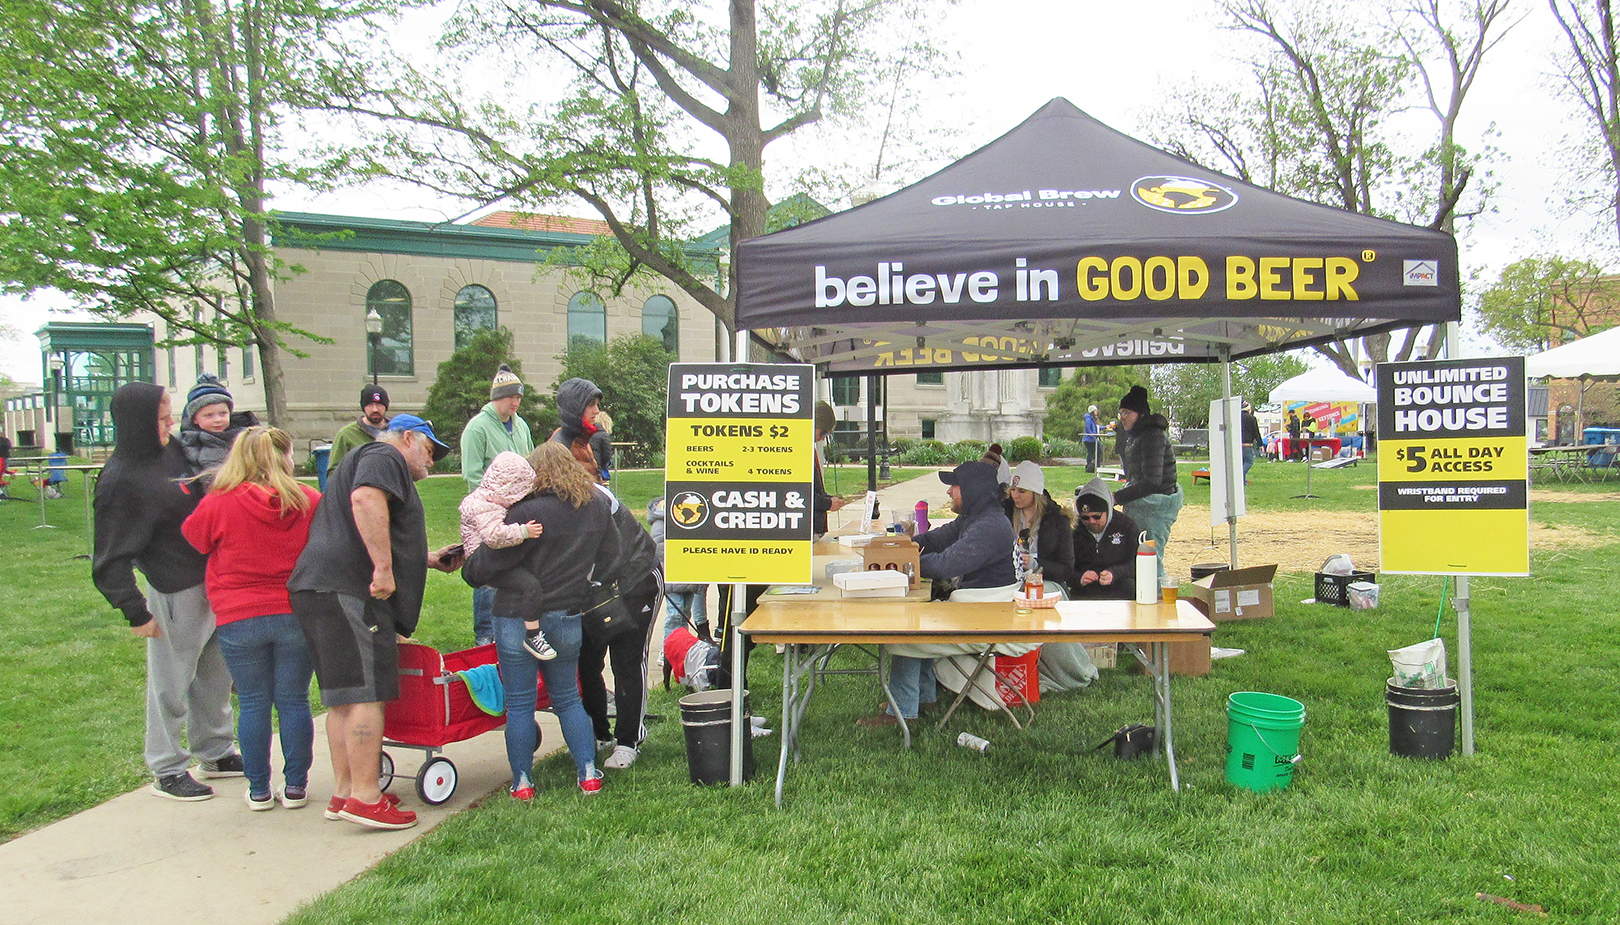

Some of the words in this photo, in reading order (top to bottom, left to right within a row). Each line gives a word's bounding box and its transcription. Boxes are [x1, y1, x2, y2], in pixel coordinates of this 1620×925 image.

[931, 190, 1032, 206] Global
[1039, 189, 1121, 200] Brew
[815, 263, 998, 308] believe
[1016, 257, 1058, 301] in
[1076, 255, 1210, 302] GOOD
[682, 374, 800, 390] PURCHASE
[1394, 367, 1507, 384] UNLIMITED
[681, 393, 800, 413] TOKENS
[1394, 384, 1507, 405] BOUNCE
[1394, 407, 1508, 432] HOUSE
[691, 425, 763, 437] TOKENS
[770, 424, 789, 439] $2
[1396, 446, 1427, 473] $5
[1431, 447, 1462, 459] ALL
[1469, 446, 1504, 459] DAY
[1431, 461, 1493, 473] ACCESS
[686, 467, 693, 475] &
[696, 467, 719, 475] WINE
[1398, 487, 1455, 495] WRISTBAND
[1457, 486, 1507, 495] REQUIRED
[1445, 494, 1479, 502] ENTRY
[712, 491, 777, 508] CASH
[785, 492, 806, 509] &
[714, 511, 803, 529] CREDIT
[683, 547, 718, 555] PLEASE
[721, 547, 746, 555] HAVE
[749, 547, 759, 555] ID
[762, 547, 793, 555] READY
